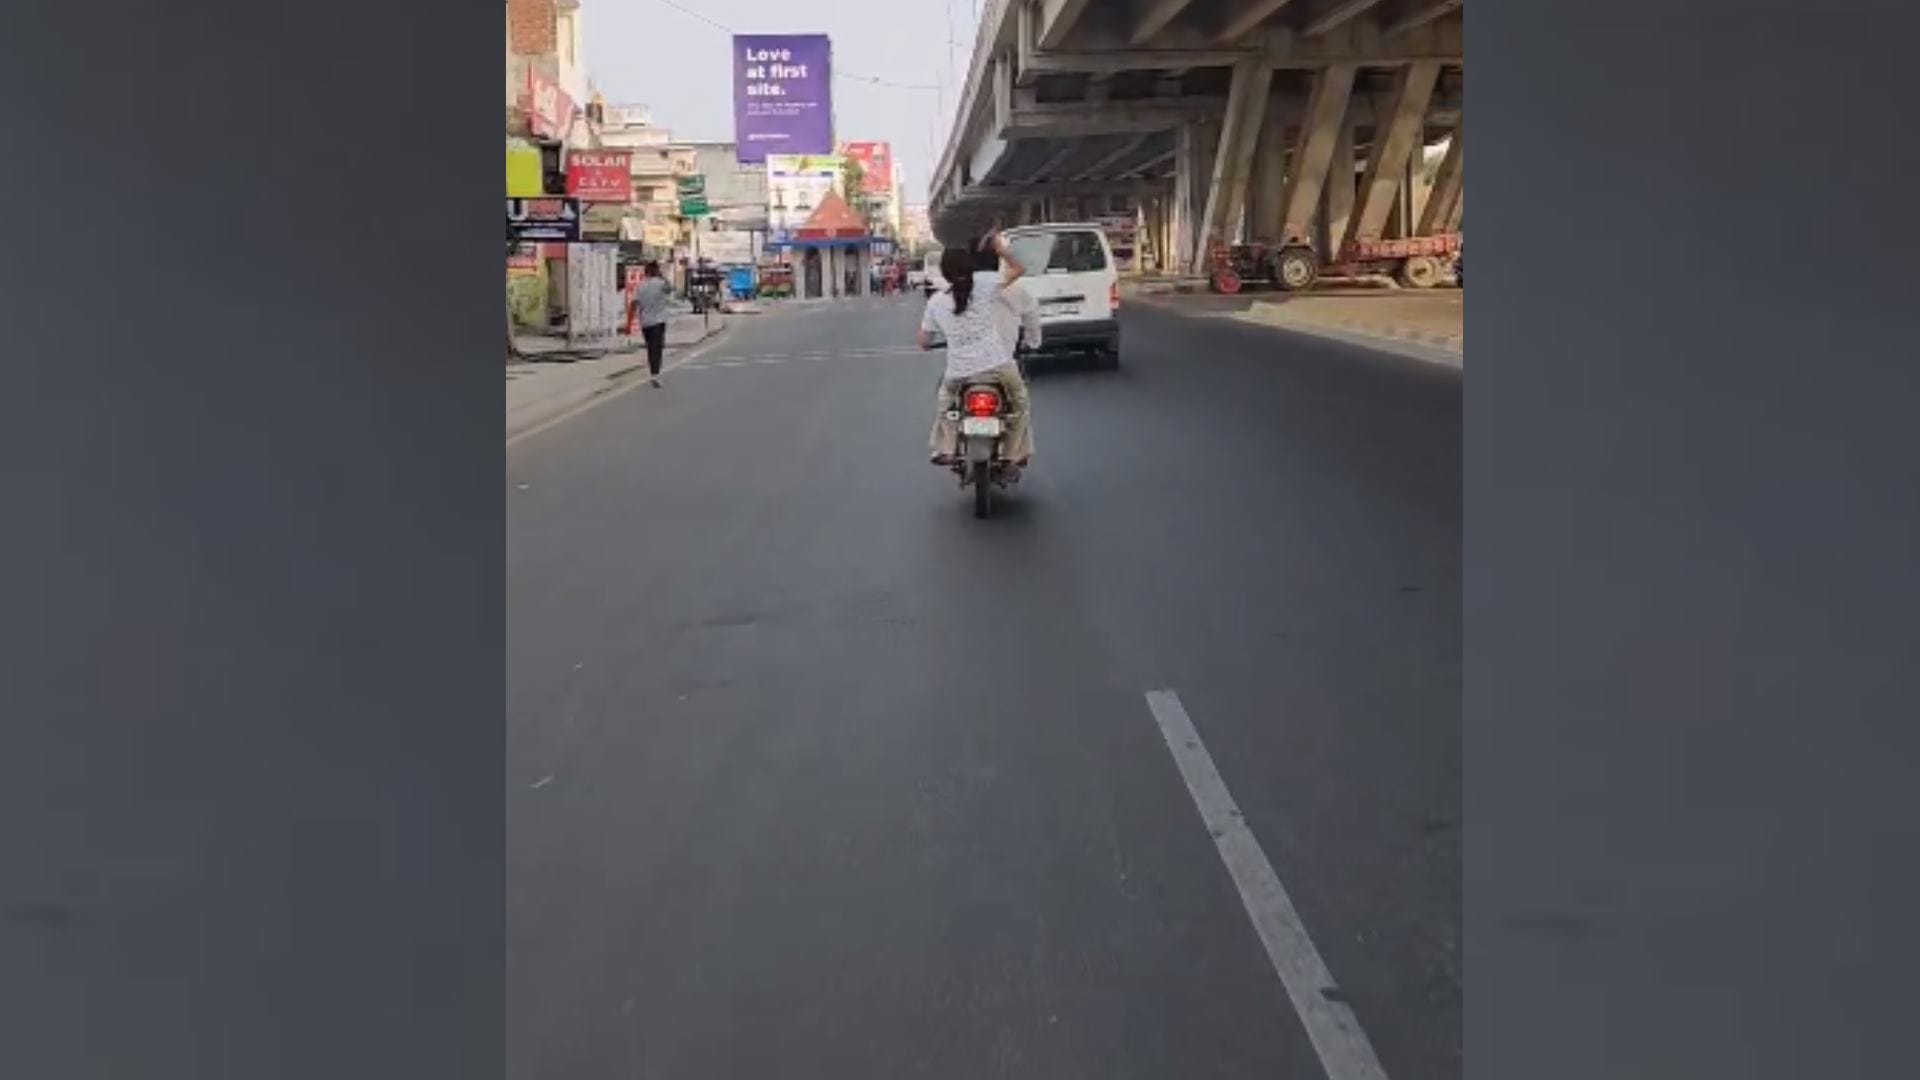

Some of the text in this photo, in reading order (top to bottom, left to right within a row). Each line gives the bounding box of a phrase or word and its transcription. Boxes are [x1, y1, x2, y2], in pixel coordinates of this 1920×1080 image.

[746, 47, 792, 62] Love
[746, 63, 808, 79] at first
[746, 82, 787, 96] site.
[570, 153, 627, 167] SOLAR
